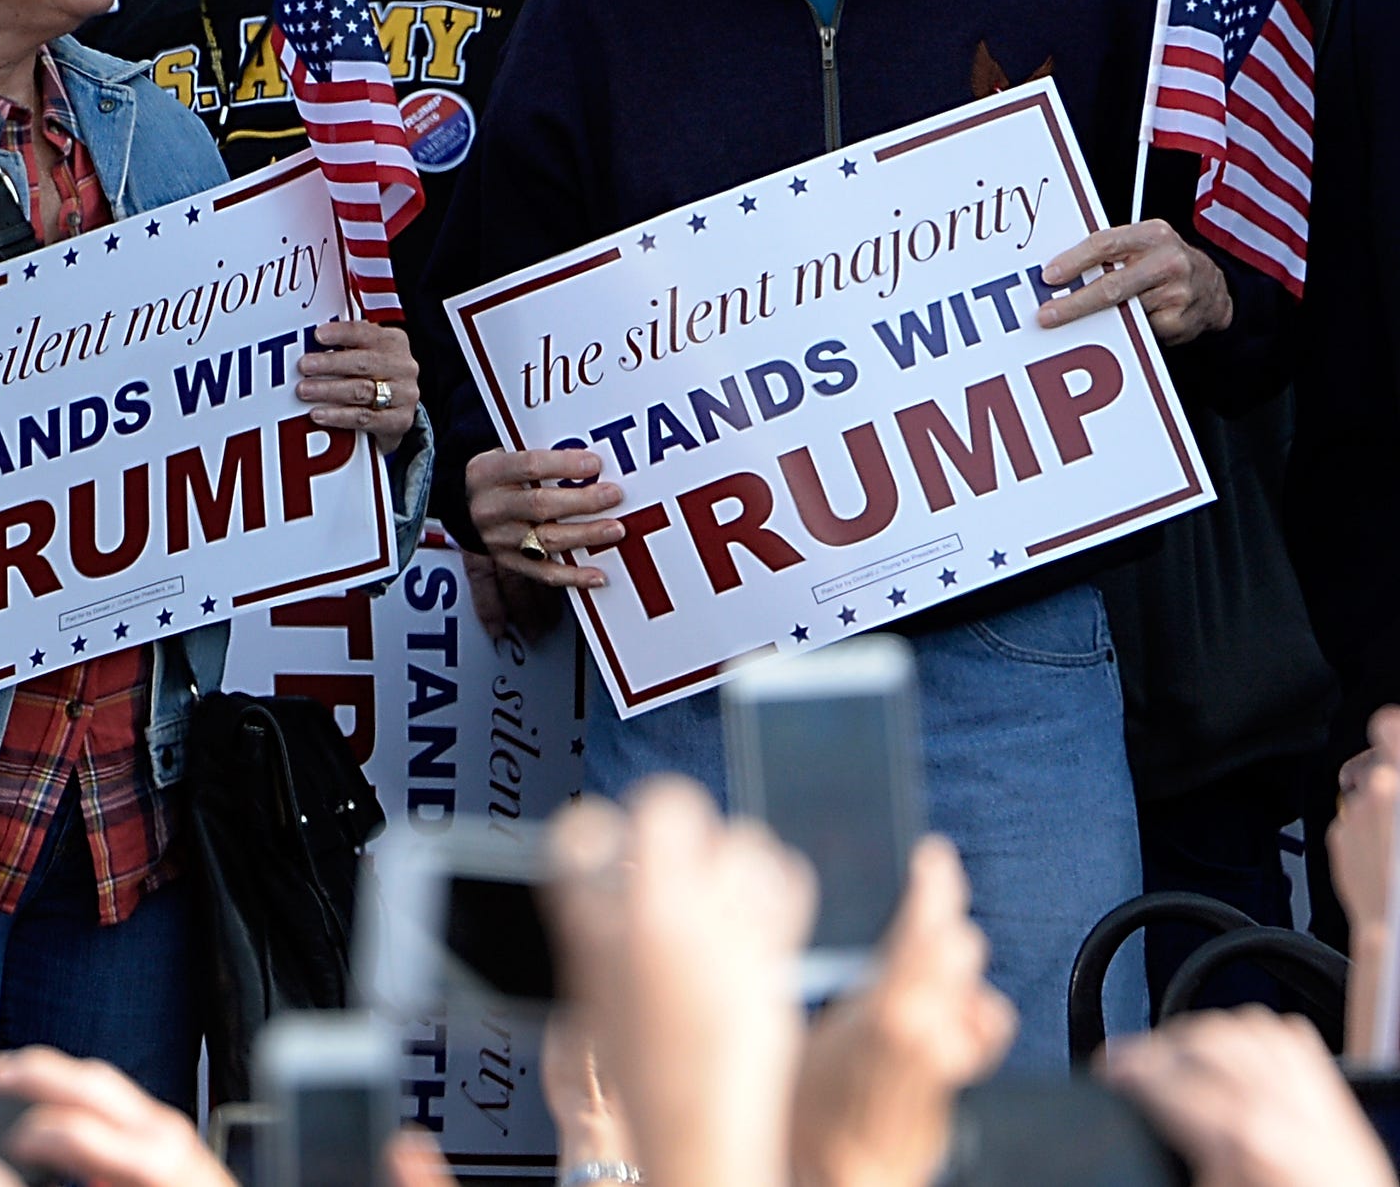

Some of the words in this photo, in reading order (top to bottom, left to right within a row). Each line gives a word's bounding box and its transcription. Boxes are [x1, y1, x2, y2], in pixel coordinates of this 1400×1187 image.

[403, 94, 443, 129] RUMP
[122, 234, 330, 346] majority
[519, 334, 605, 411] the
[617, 269, 777, 372] silent
[793, 176, 1050, 299] majority
[585, 344, 1125, 621] TRUMP
